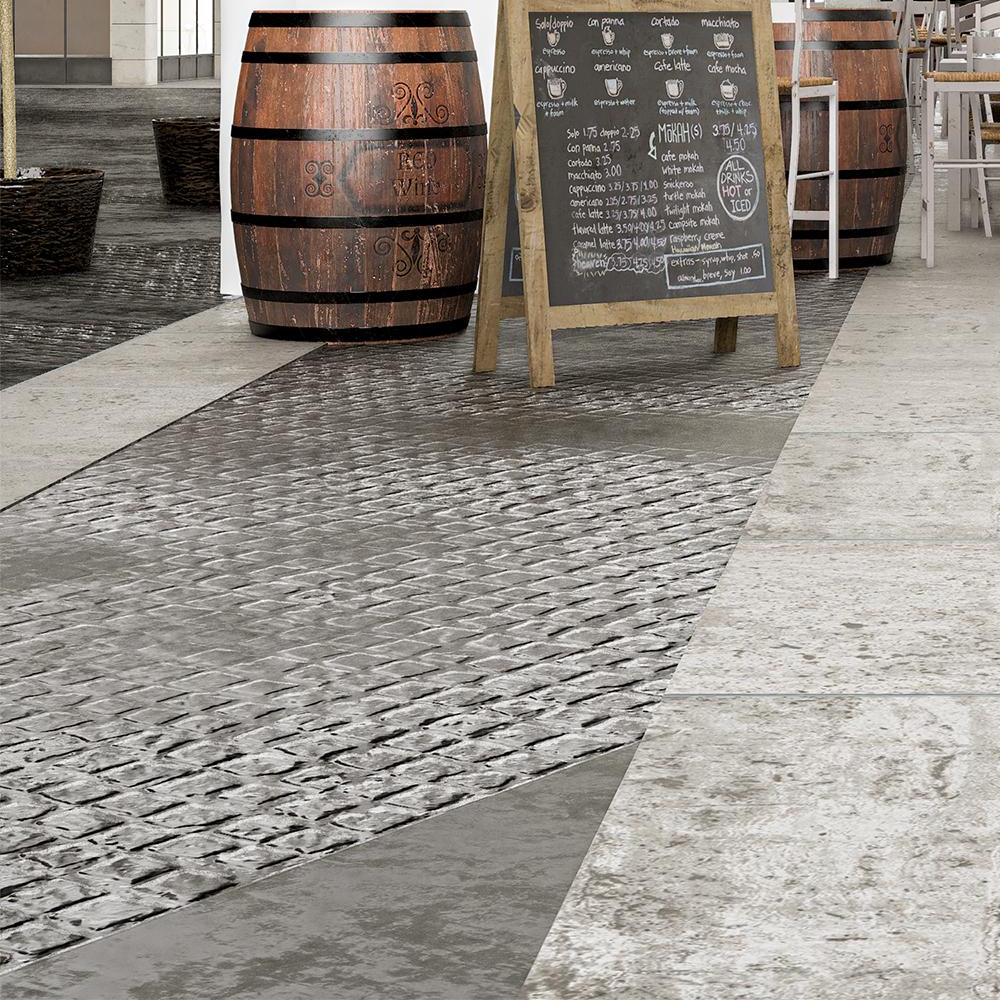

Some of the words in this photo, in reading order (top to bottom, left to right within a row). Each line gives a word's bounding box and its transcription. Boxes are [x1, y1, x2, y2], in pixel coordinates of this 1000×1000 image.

[601, 17, 625, 30] panna
[701, 16, 740, 29] macchiato
[534, 60, 576, 79] cappuccino
[594, 60, 632, 72] americano
[673, 57, 692, 72] latte
[725, 64, 747, 76] mocha
[565, 97, 579, 107] milk
[583, 125, 598, 139] 1.75
[600, 125, 620, 140] doppio
[621, 126, 641, 140] 2.25
[603, 140, 621, 153] 2.75
[679, 150, 700, 163] mokah
[568, 169, 603, 181] macchiato
[604, 163, 622, 179] 3.00
[684, 162, 704, 175] mokah
[725, 159, 745, 172] ALL
[720, 170, 754, 185] DRINKS
[663, 190, 684, 201] turtle
[685, 187, 706, 200] mokah
[722, 184, 742, 198] HOT
[744, 187, 753, 197] or
[570, 195, 603, 208] americano
[730, 199, 752, 214] ICED
[587, 207, 604, 220] latte
[664, 202, 690, 221] twilight
[692, 201, 714, 214] mokah
[597, 222, 614, 236] latte
[669, 231, 701, 248] raspberry
